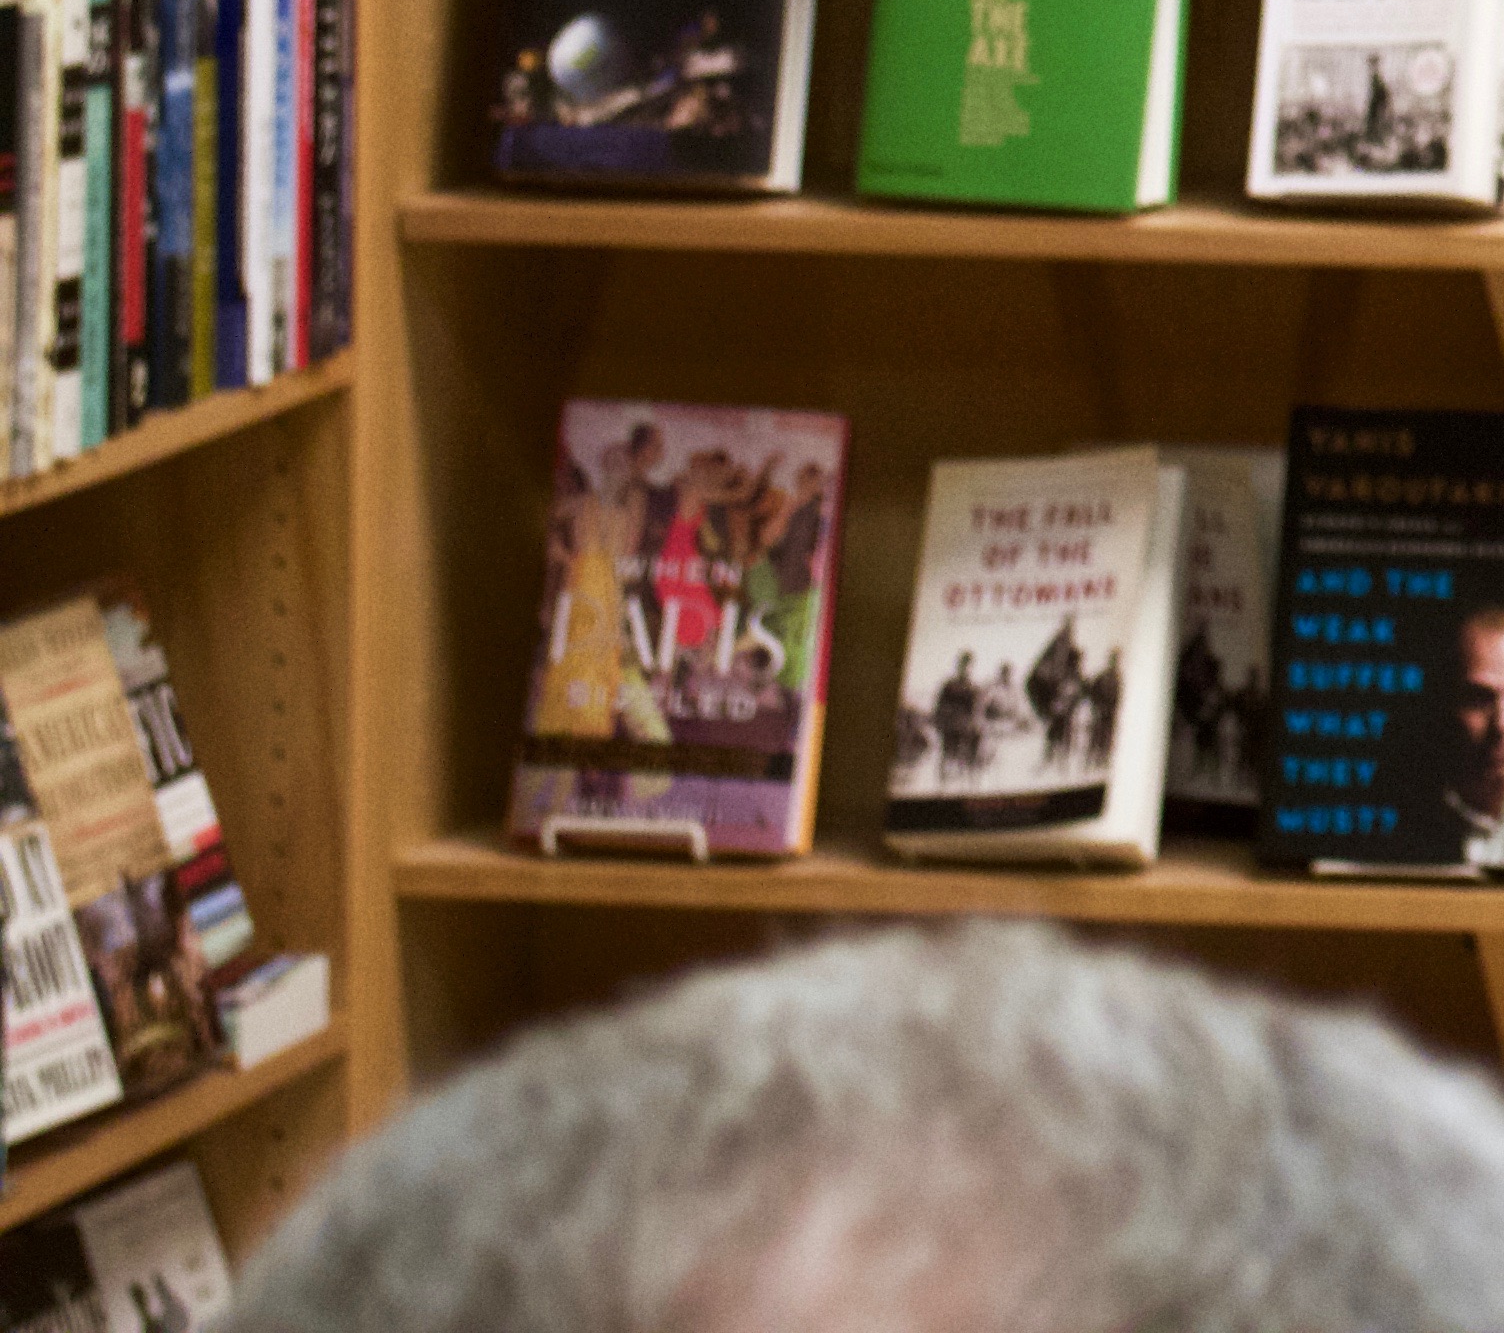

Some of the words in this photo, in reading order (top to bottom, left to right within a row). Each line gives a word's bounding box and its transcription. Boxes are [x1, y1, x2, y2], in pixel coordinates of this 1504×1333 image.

[972, 0, 1031, 34] THE
[967, 33, 1031, 73] AXE
[971, 505, 1030, 530] THE
[1039, 501, 1114, 528] FALL
[981, 544, 1021, 569] OF
[1037, 543, 1092, 567] THE
[943, 576, 1117, 609] OTTOMANS
[1296, 567, 1372, 597] AND
[1386, 568, 1454, 599] THE
[1291, 614, 1396, 644] WEAK
[1288, 660, 1425, 693] SUFFER
[1284, 710, 1386, 739] WHAT
[1282, 755, 1376, 787] THEY
